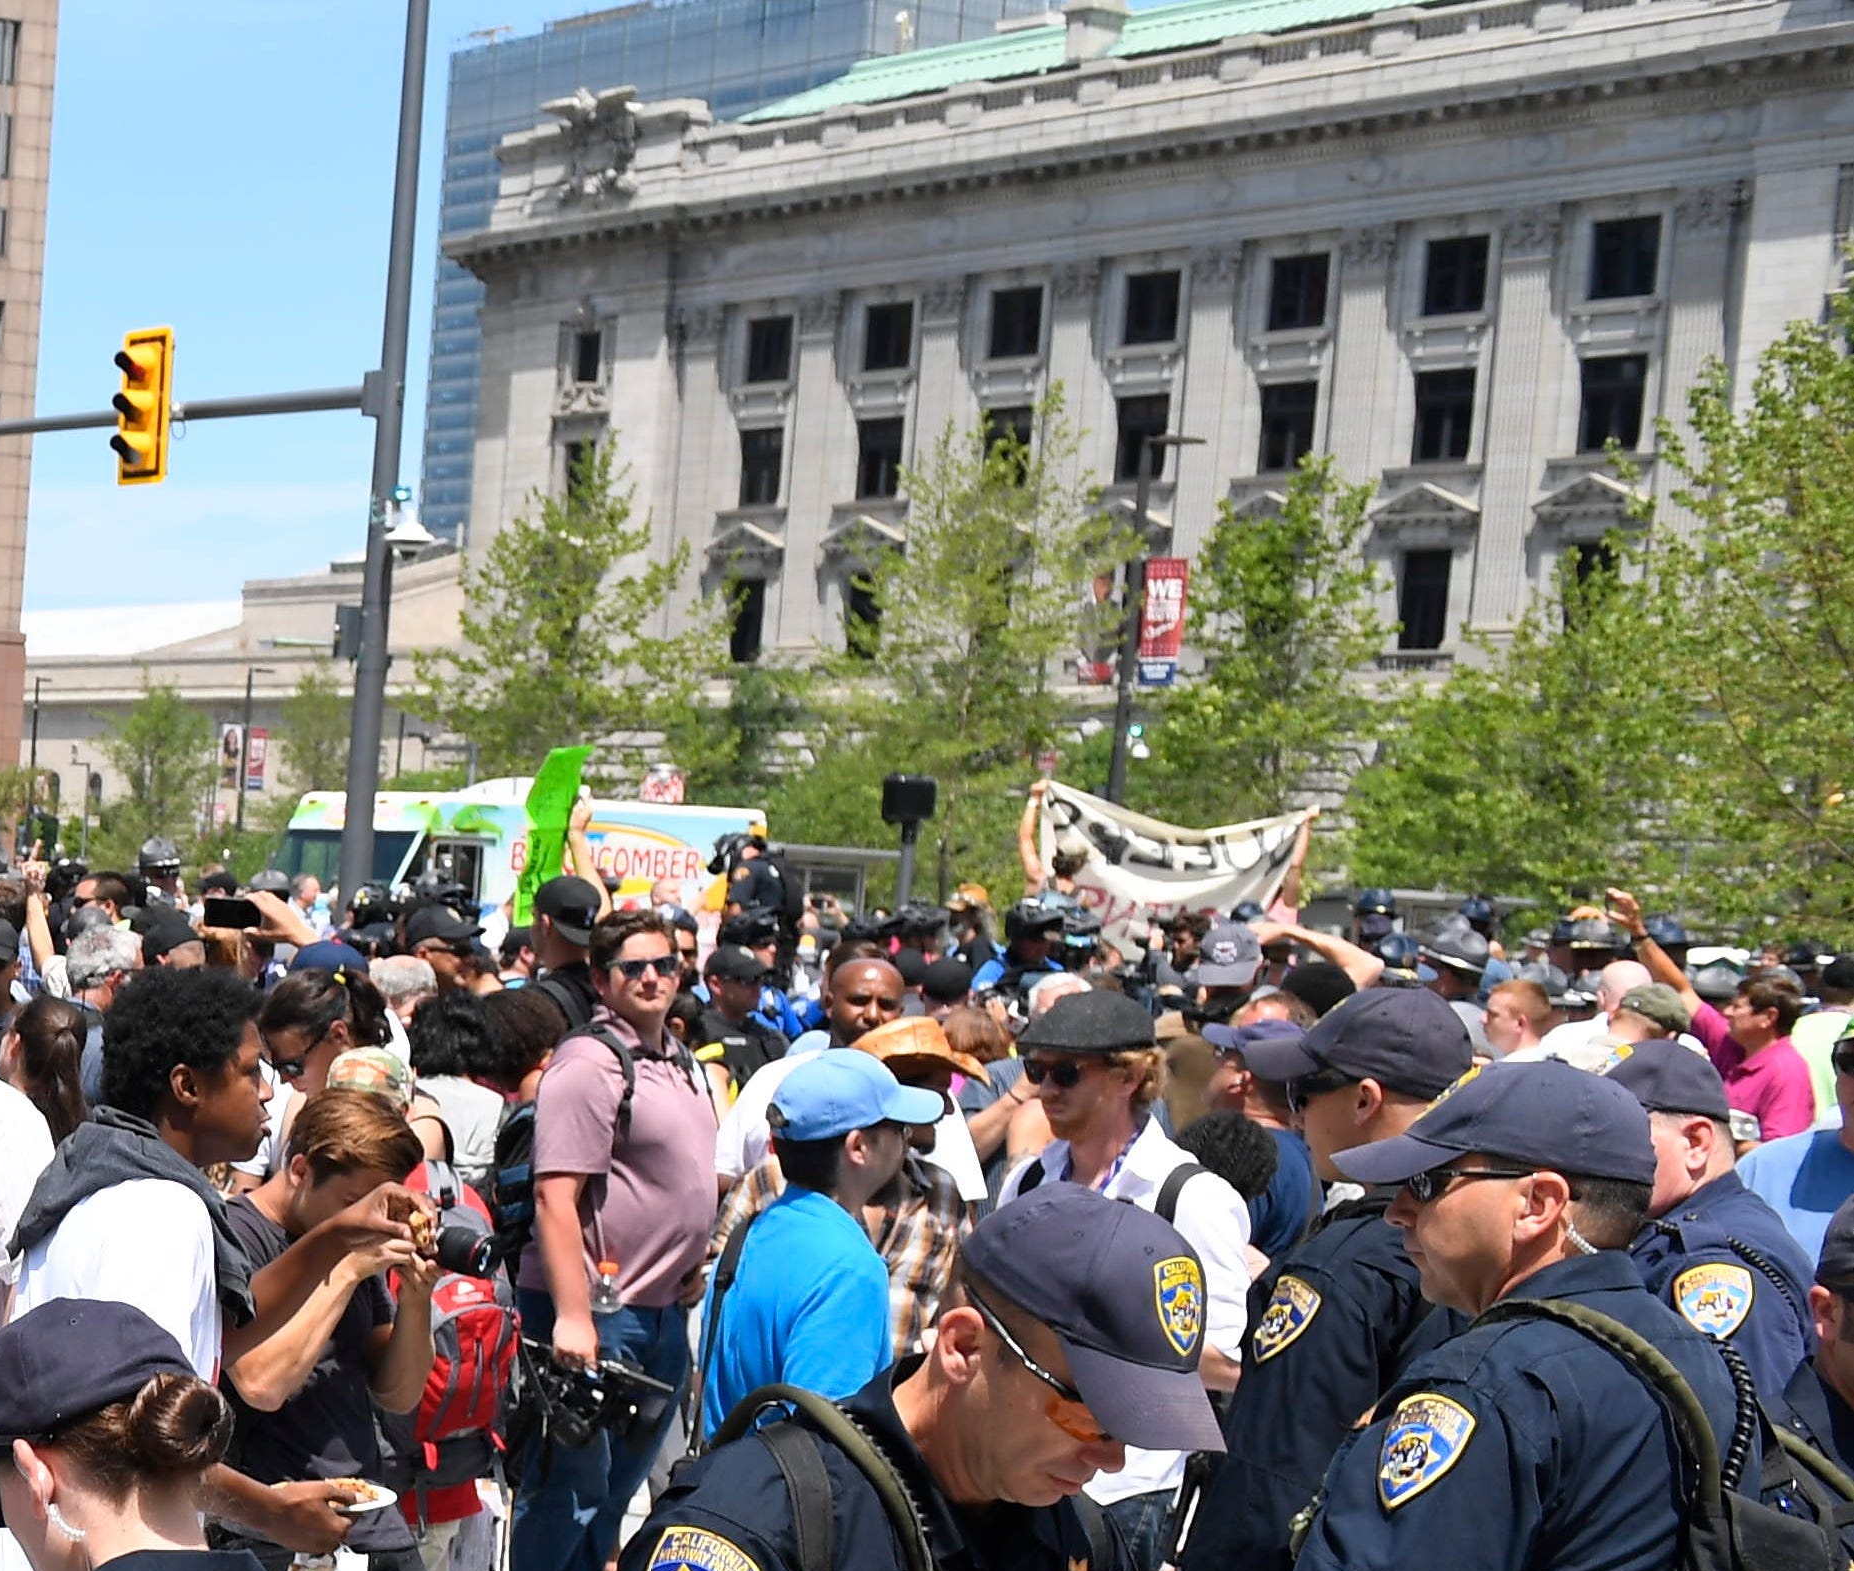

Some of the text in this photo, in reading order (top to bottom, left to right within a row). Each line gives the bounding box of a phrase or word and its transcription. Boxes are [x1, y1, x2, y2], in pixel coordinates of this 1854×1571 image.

[1148, 578, 1183, 599] WE
[511, 840, 700, 880] BCOMBER
[659, 1548, 710, 1563] HIGHWAY
